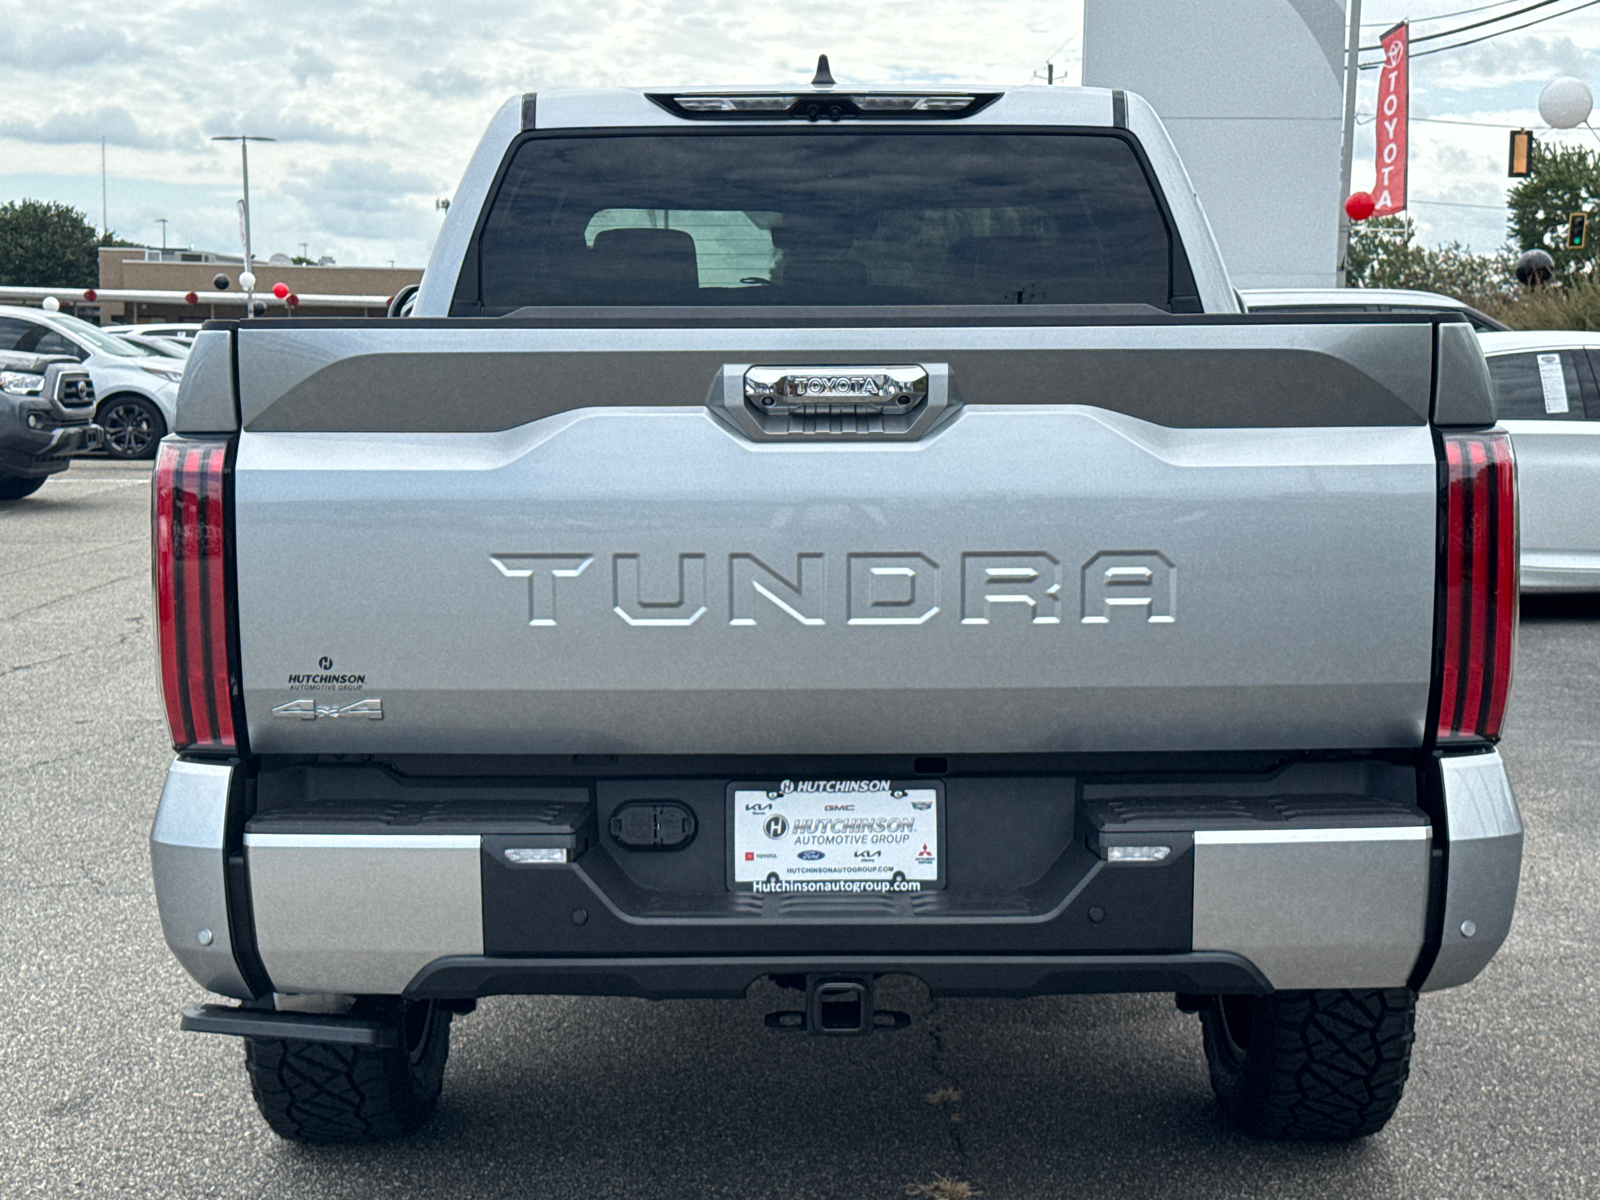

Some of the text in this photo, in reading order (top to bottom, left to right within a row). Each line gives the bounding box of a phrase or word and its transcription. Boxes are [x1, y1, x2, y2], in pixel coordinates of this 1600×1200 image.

[1374, 71, 1398, 209] TOYOTA
[794, 377, 879, 395] TOYOTA
[489, 550, 1178, 627] TUNDRA
[288, 674, 366, 684] HUTCHINSON
[797, 780, 891, 793] HUTCHINSON
[745, 803, 773, 811] KIA
[792, 817, 915, 834] HUTCHINSON
[794, 834, 910, 845] AUTOMOTIVE GROUP
[854, 850, 881, 858] KIA
[787, 866, 894, 874] HUTCHINSONAUTOGROUP.COM
[753, 880, 921, 893] Hutchinsonautogroup.com
